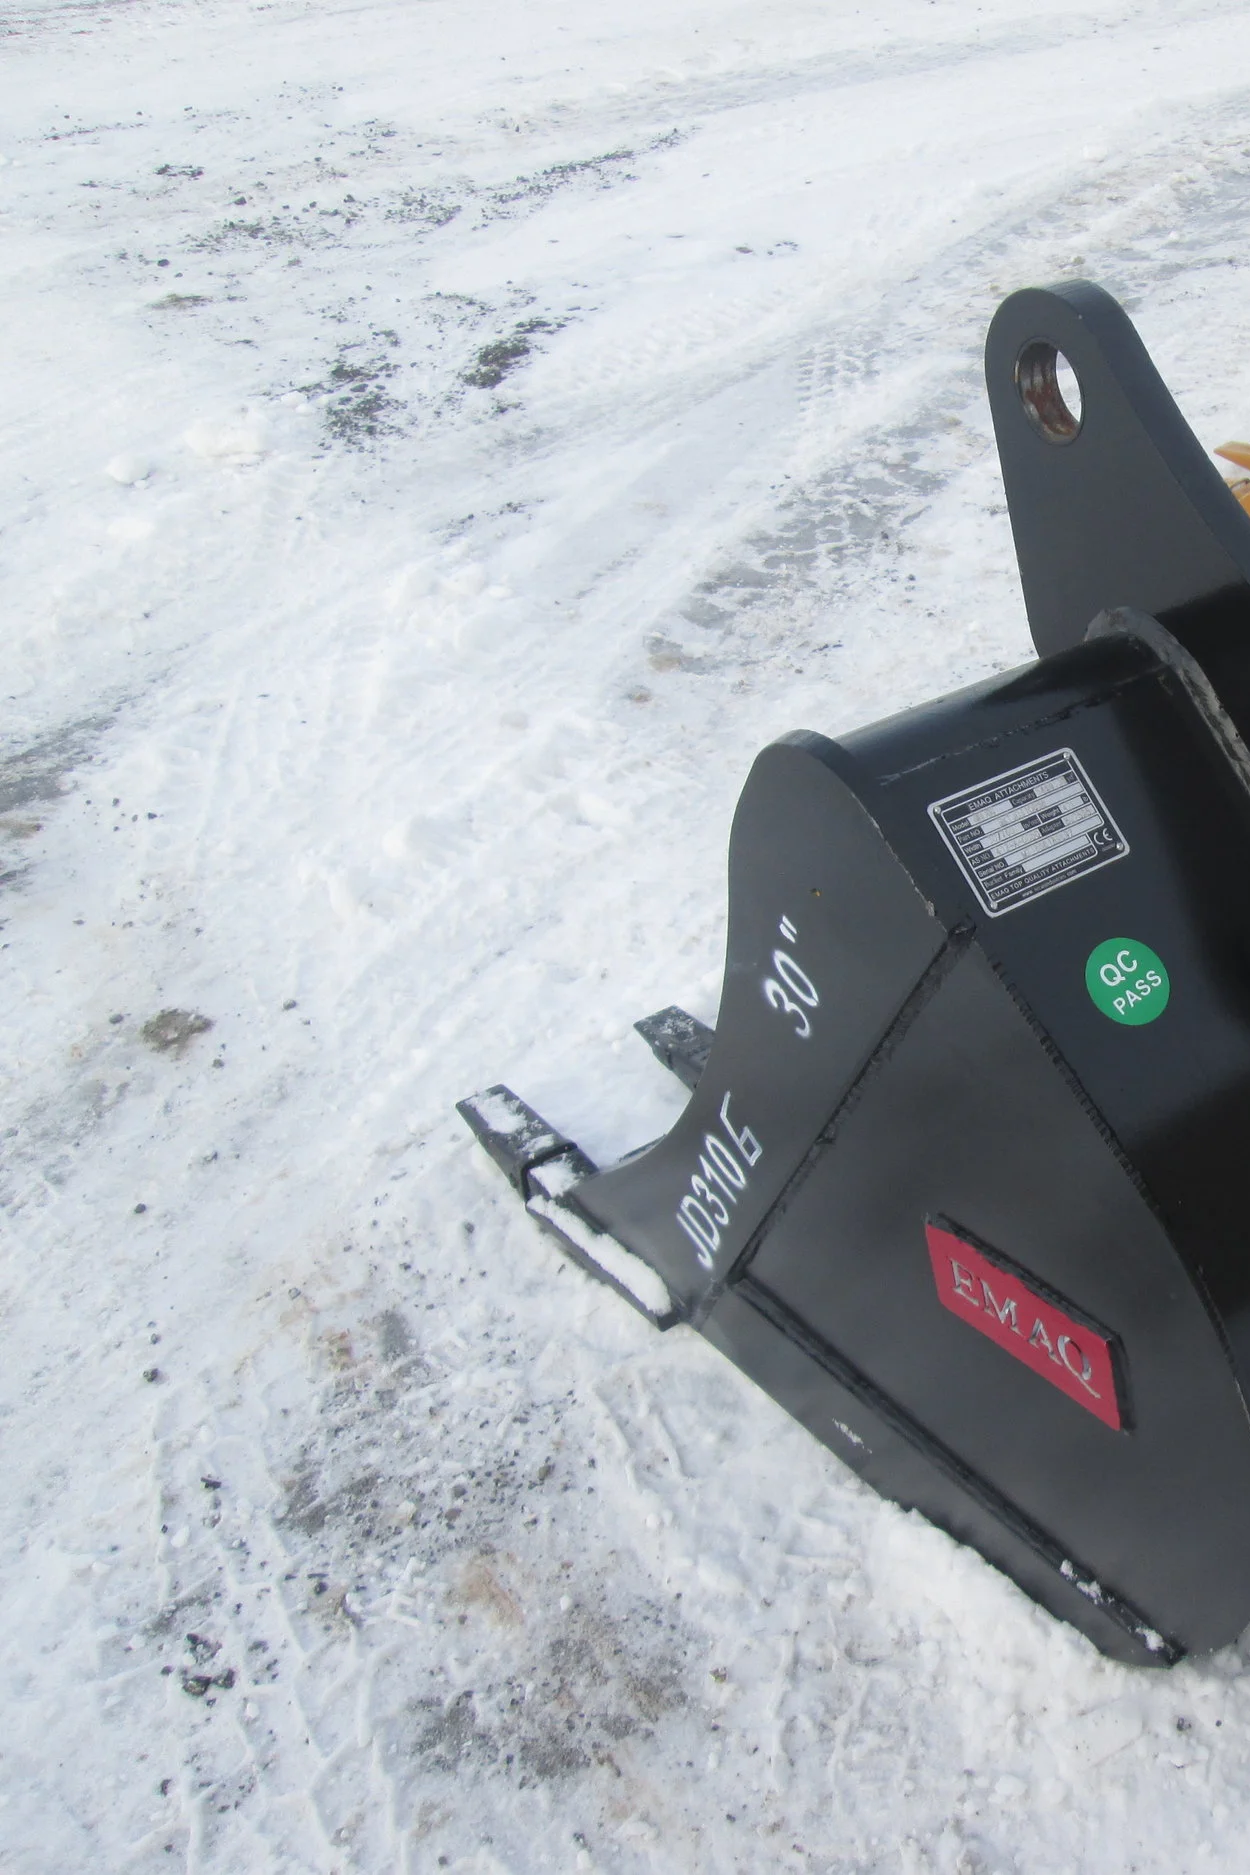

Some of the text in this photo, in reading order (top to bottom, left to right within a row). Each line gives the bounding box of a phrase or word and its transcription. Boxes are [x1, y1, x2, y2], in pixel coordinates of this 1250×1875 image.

[968, 797, 992, 811] EMAQ
[993, 771, 1049, 800] ATTACHMENTS
[951, 819, 969, 831] Model
[990, 886, 1010, 899] EMAQ
[1009, 879, 1023, 890] TOP
[1023, 867, 1050, 884] QUALITY
[1049, 845, 1095, 871] ATTACHMENTS
[1003, 865, 1024, 879] Family
[761, 914, 819, 1039] 30"
[1099, 950, 1138, 987] QC
[1112, 970, 1162, 1015] PASS
[948, 1256, 1102, 1399] EMAQ
